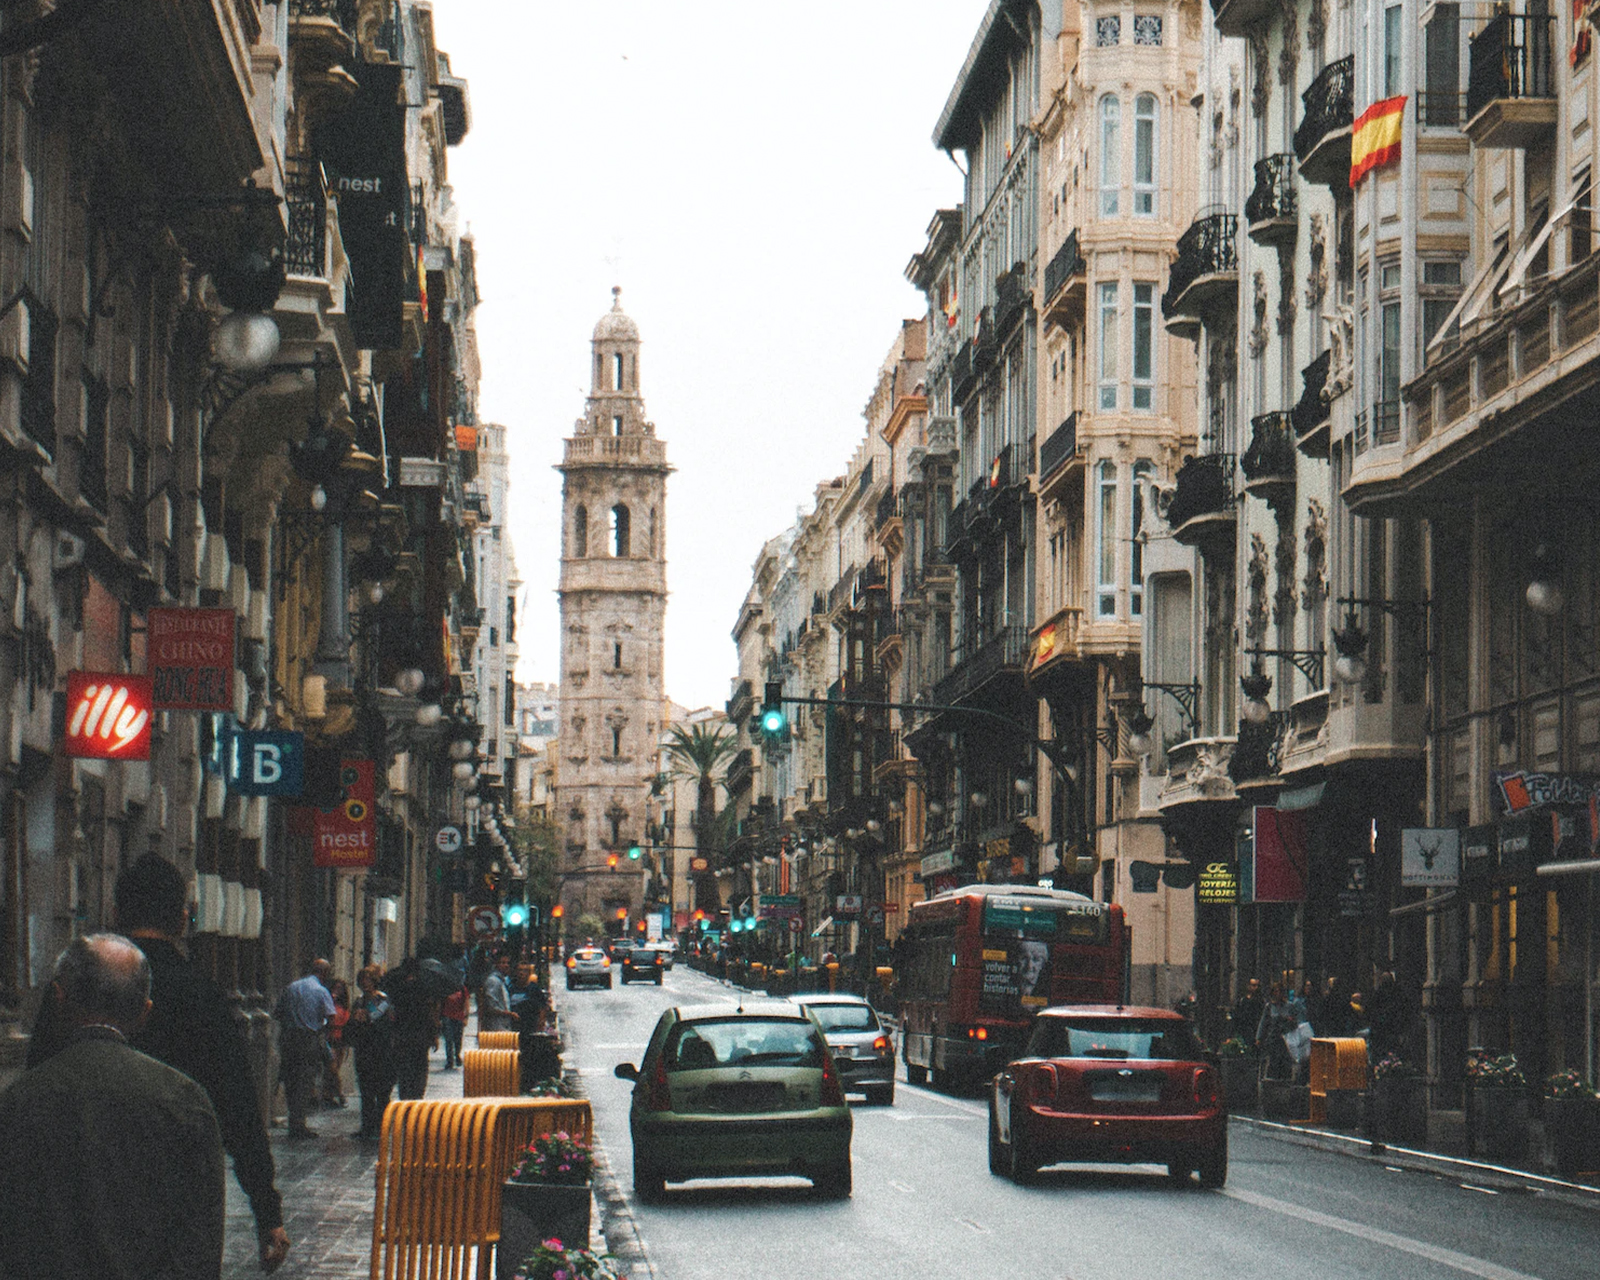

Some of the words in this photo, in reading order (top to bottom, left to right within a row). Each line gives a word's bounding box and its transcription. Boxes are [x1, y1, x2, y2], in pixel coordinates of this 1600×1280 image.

[337, 176, 382, 193] nest
[158, 640, 224, 660] CHINO
[68, 684, 149, 752] illy
[321, 830, 371, 848] nest
[330, 848, 369, 859] Hostel
[1199, 880, 1237, 888] JOYERÍA
[1198, 889, 1237, 897] RELOJES
[984, 962, 1010, 974] volver
[984, 973, 1010, 984] contar
[983, 982, 1019, 995] historias
